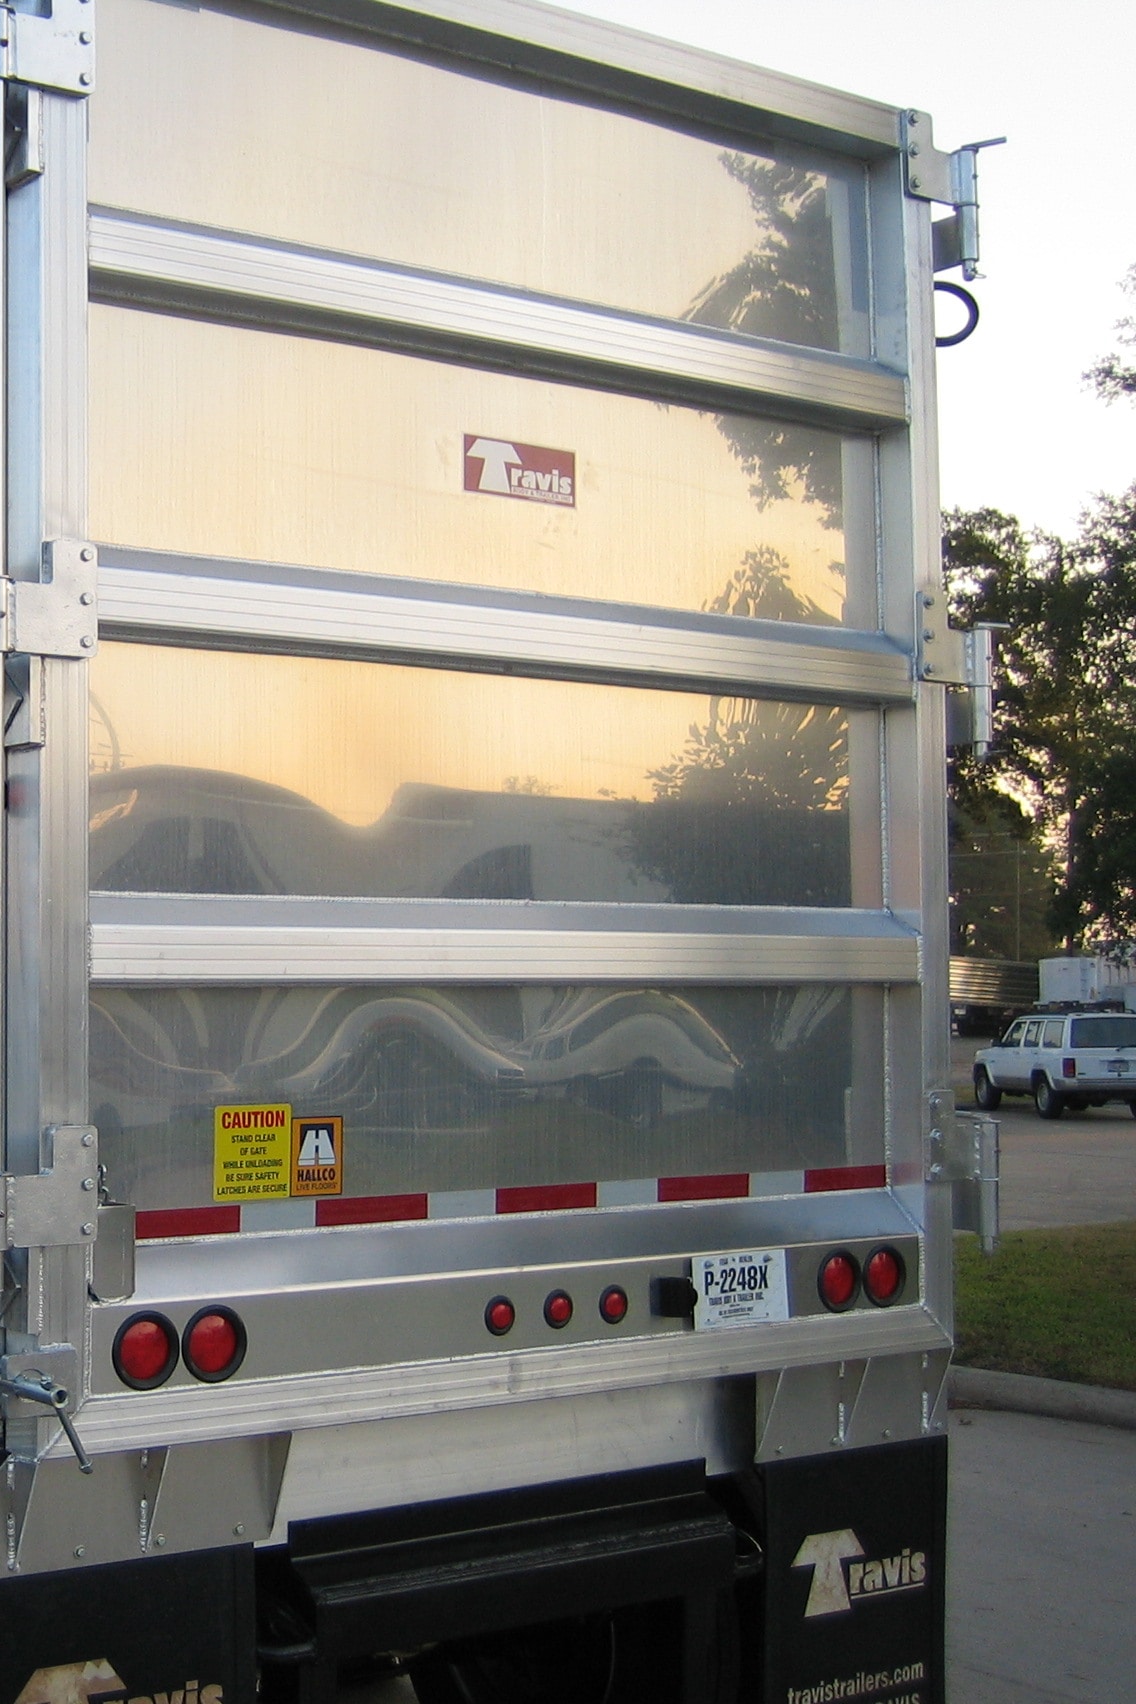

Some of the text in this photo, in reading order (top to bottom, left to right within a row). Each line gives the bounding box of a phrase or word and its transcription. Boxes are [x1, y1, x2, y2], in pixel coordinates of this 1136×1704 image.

[466, 438, 572, 495] Travis
[221, 1110, 286, 1129] CAUTION
[231, 1134, 276, 1143] STAND CLEAR
[240, 1147, 267, 1156] OF GATE
[223, 1159, 282, 1169] WHILE UNLOADING
[226, 1172, 279, 1182] BE SURE SAFETY
[297, 1168, 336, 1182] HALLCO
[217, 1183, 287, 1195] LATCHES ARE SECURE
[704, 1264, 768, 1296] P-2248X
[790, 1528, 926, 1617] Travis
[787, 1662, 924, 1704] travistrailers.com
